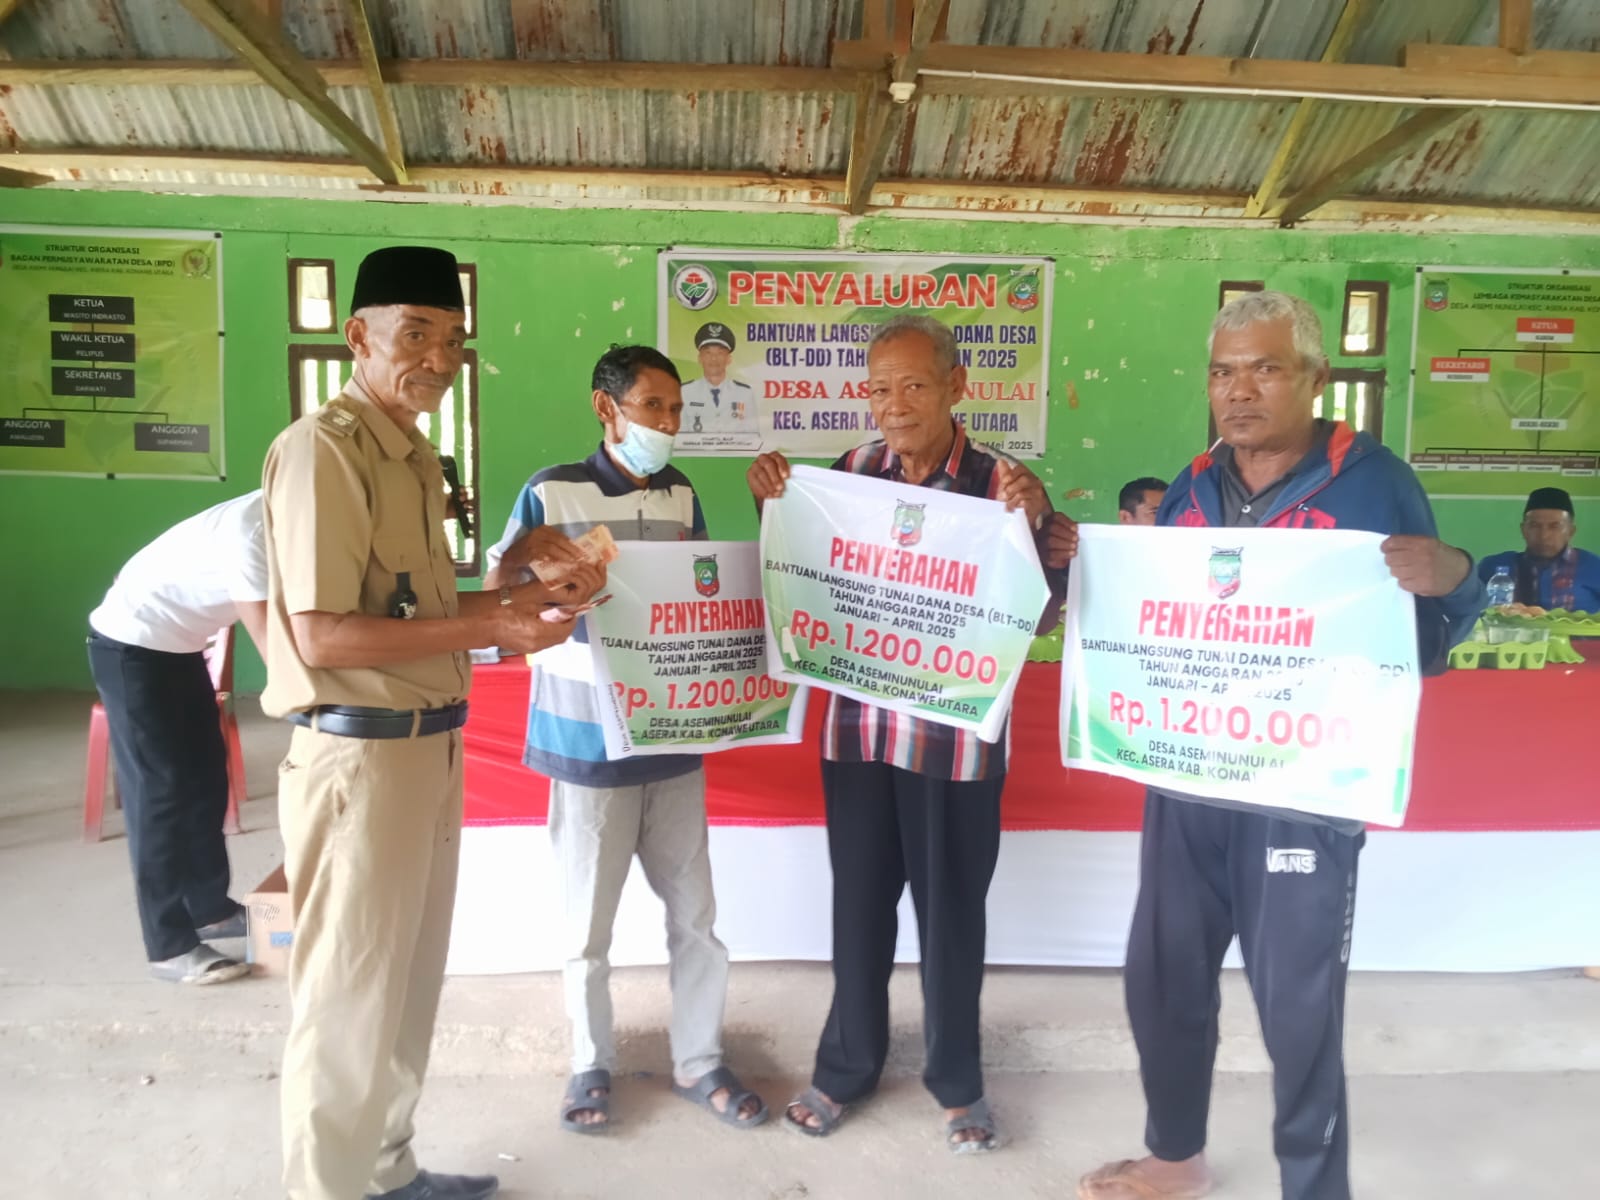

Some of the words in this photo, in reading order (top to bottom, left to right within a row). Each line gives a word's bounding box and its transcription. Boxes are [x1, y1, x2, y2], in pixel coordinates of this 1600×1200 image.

[45, 244, 86, 252] STRUKTUR
[88, 245, 140, 255] ORGANISASI
[11, 254, 41, 263] BADAN
[131, 258, 152, 266] DESA
[154, 259, 176, 267] (BPD)
[728, 271, 997, 309] PENYALURAN
[74, 298, 105, 309] KETUA
[60, 333, 93, 344] WAKIL
[94, 335, 125, 345] KETUA
[747, 323, 816, 342] BANTUAN
[821, 324, 879, 343] LANGS
[954, 324, 994, 344] DANA
[999, 325, 1036, 344] DESA
[766, 348, 831, 367] (BLT-DD)
[837, 348, 869, 367] TAH
[977, 349, 1017, 368] 2025
[64, 370, 122, 381] SEKRETARIS
[764, 380, 829, 399] DESA
[4, 419, 51, 430] ANGGOTA
[151, 425, 198, 435] ANGGOTA
[773, 411, 806, 430] KEC.
[811, 411, 859, 430] ASERA
[972, 413, 1018, 432] UTARA
[1008, 441, 1033, 450] 2025
[829, 536, 979, 597] PENYERAHAN
[765, 559, 818, 580] BANTUAN
[818, 571, 877, 597] LANGSUNG
[879, 586, 916, 604] TUNAI
[916, 594, 952, 612] DANA
[954, 602, 985, 619] DESA
[987, 608, 1036, 636] (BLT-DD)
[829, 587, 865, 606] TAHUN
[867, 596, 936, 621] ANGGARAN
[937, 612, 967, 628] 2025
[649, 598, 766, 636] PENYERAHAN
[833, 602, 881, 623] JANUARI
[891, 616, 925, 633] APRIL
[927, 623, 957, 639] 2025
[1138, 599, 1315, 648] PENYERAHAN
[635, 637, 695, 652] LANGSUNG
[697, 637, 726, 651] TUNAI
[727, 636, 752, 648] DANA
[790, 609, 837, 652] Rp.
[844, 622, 999, 685] 1.200.000
[1081, 638, 1127, 655] BANTUAN
[1127, 643, 1193, 661] LANGSUNG
[1239, 652, 1282, 669] DANA
[1286, 655, 1320, 670] DES
[648, 652, 686, 664] TAHUN
[688, 649, 742, 663] ANGGARAN
[742, 646, 763, 659] 2025
[654, 664, 700, 677] JANUARI
[710, 660, 736, 674] APRIL
[736, 658, 757, 672] 2025
[830, 655, 856, 672] DESA
[858, 662, 944, 695] ASEMINUNULAI
[1139, 659, 1179, 674] TAHUN
[1181, 662, 1262, 681] ANGGARAN
[666, 675, 789, 711] 1.200.000
[795, 659, 820, 675] KEC.
[821, 665, 855, 685] ASERA
[856, 676, 881, 693] KAB.
[882, 684, 937, 707] KONAWE
[938, 697, 979, 717] UTARA
[650, 715, 682, 729] DESA
[683, 711, 752, 728] ASEMINUNULAI
[1109, 691, 1153, 736] Rp.
[641, 728, 677, 740] ASERA
[678, 728, 705, 740] KAB.
[707, 724, 748, 738] KONAWE
[749, 719, 780, 733] UTARA
[1149, 739, 1176, 756] DESA
[1117, 748, 1140, 764] KEC.
[1141, 754, 1175, 772] ASERA
[1177, 761, 1204, 777] KAB.
[1266, 847, 1317, 874] VANS
